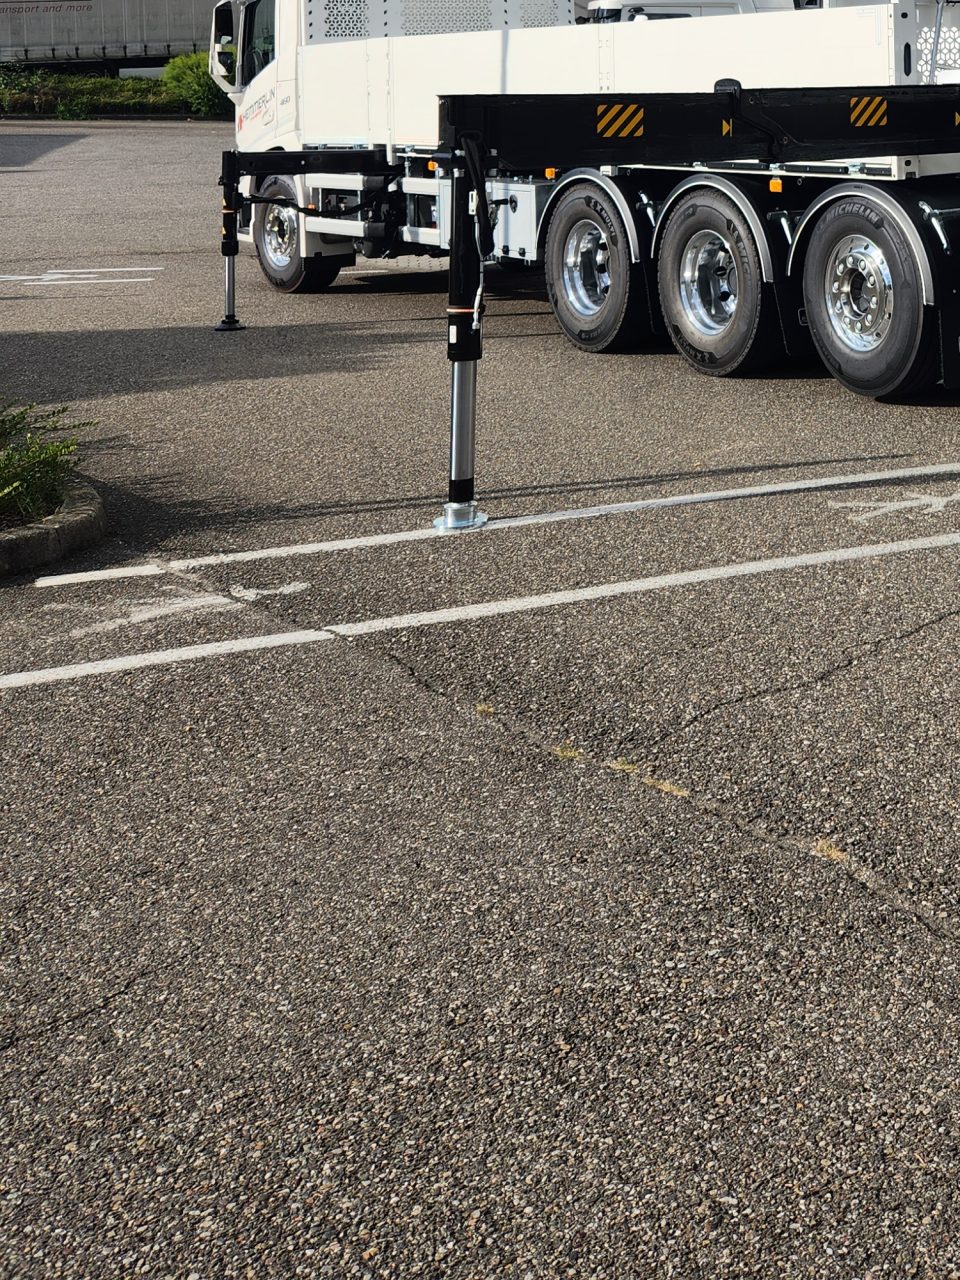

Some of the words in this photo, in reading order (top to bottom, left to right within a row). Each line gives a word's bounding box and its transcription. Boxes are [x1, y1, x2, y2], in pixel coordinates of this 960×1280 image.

[42, 4, 63, 13] and
[66, 4, 93, 12] more
[825, 204, 880, 223] MICHELIN
